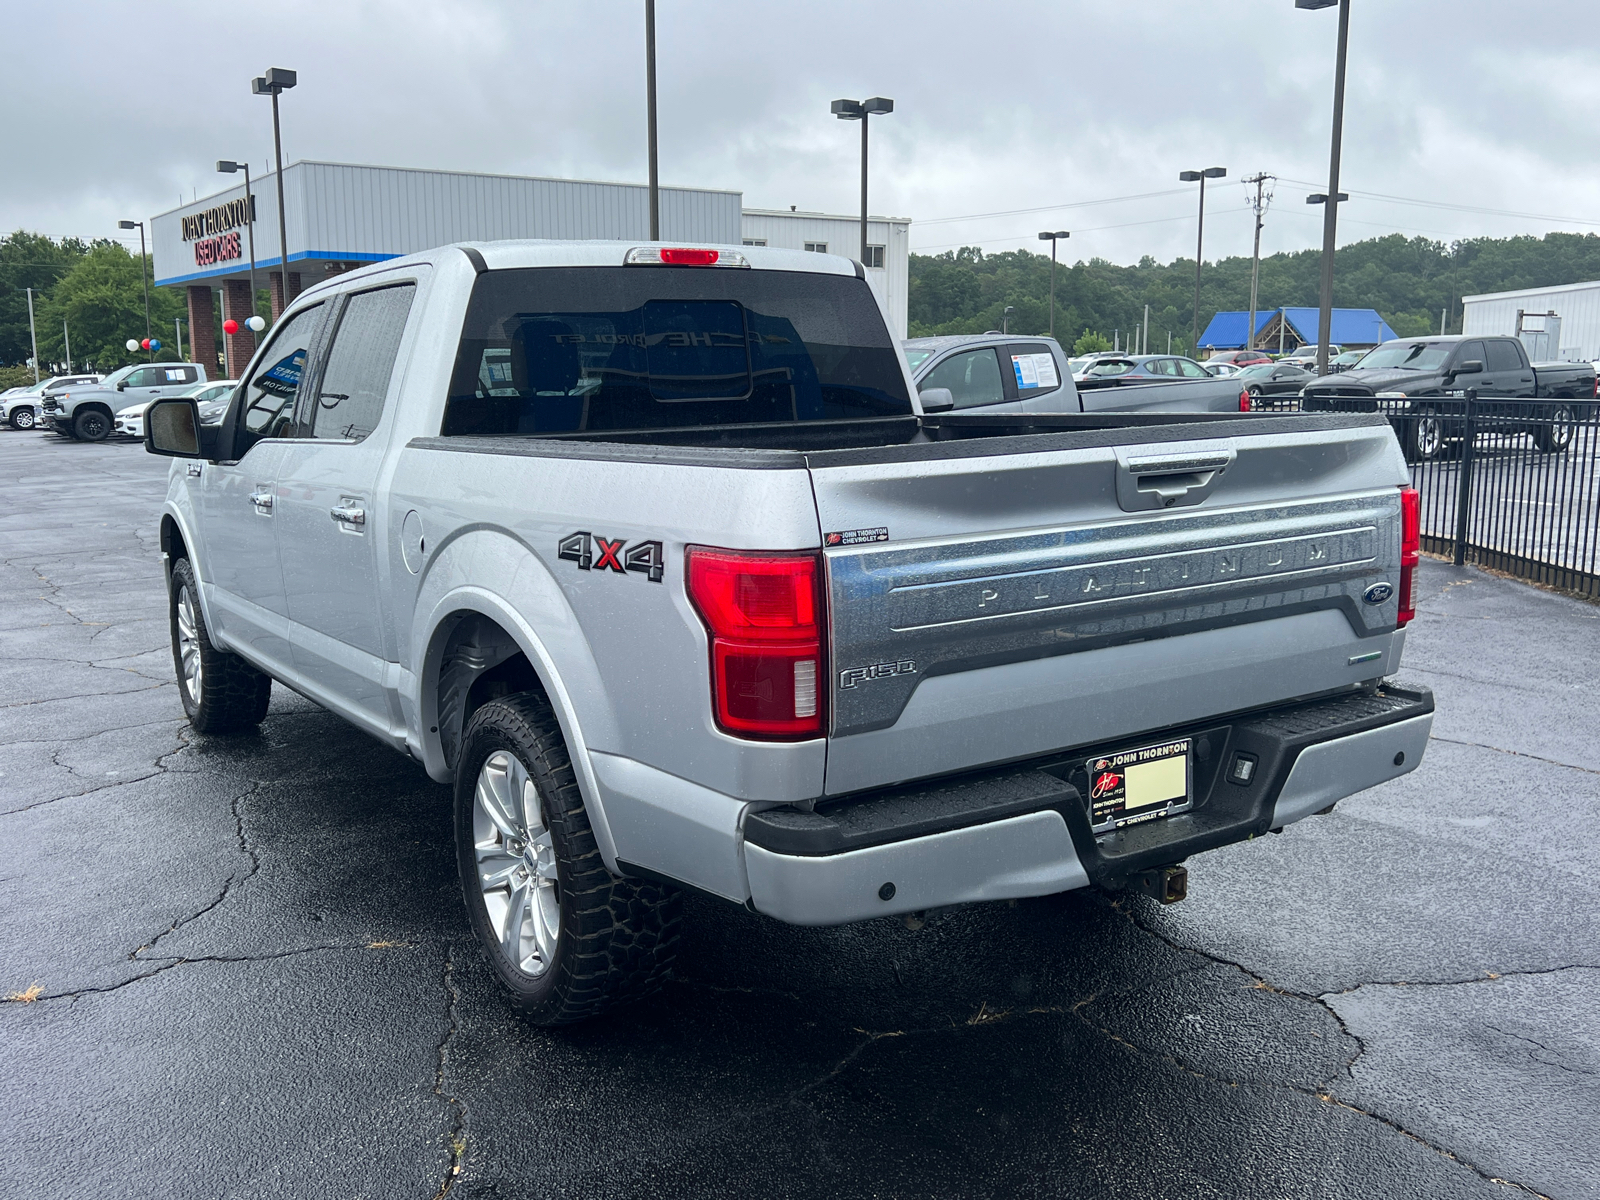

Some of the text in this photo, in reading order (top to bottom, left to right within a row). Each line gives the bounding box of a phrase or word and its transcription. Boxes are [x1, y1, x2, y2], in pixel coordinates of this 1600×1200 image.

[181, 213, 204, 241] JOHN
[194, 231, 242, 266] USED CARS
[842, 535, 877, 544] CHEVROLET
[857, 528, 887, 536] THORNTON
[557, 530, 664, 583] 4X4
[978, 543, 1326, 607] PLATINUM
[1112, 753, 1136, 766] JOHN
[1139, 742, 1187, 760] THORNTON
[1126, 812, 1158, 825] CHEVROLET
